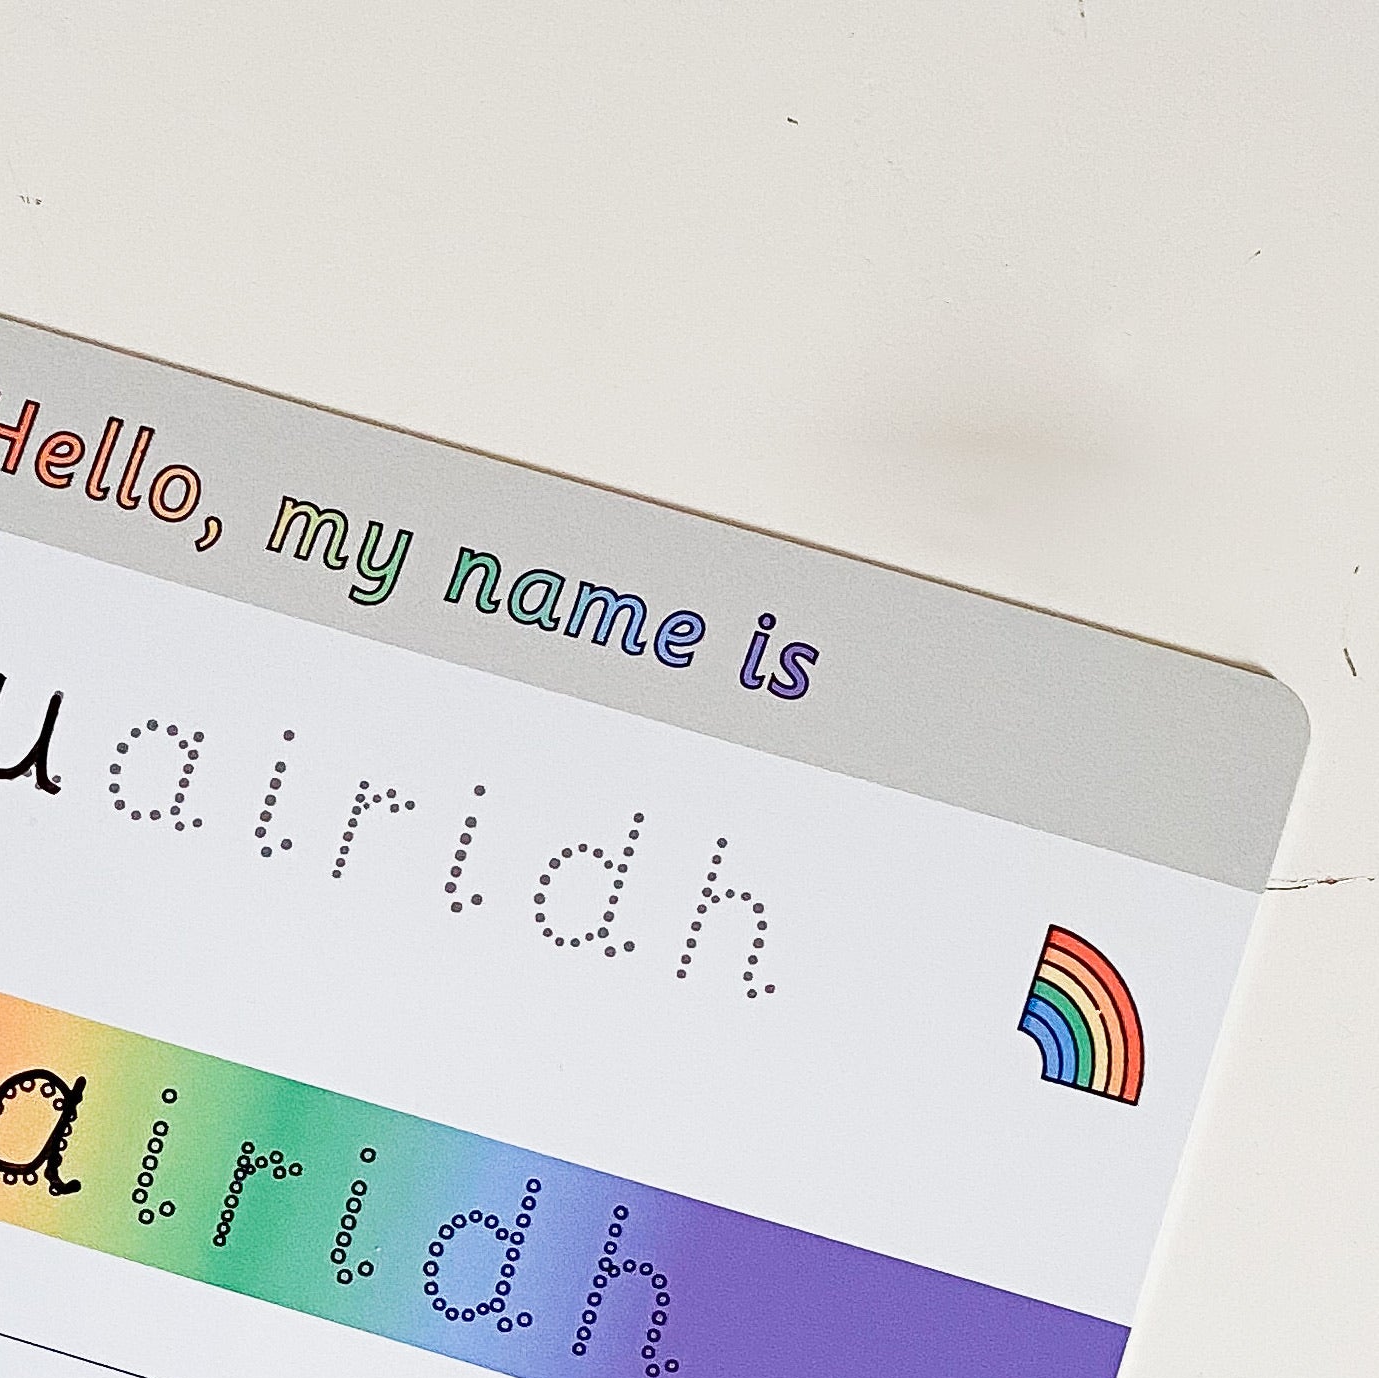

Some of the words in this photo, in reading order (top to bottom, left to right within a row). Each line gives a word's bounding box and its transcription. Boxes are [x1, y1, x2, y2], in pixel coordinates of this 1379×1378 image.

[265, 495, 414, 606] my
[443, 546, 707, 669] name
[738, 612, 821, 700] is
